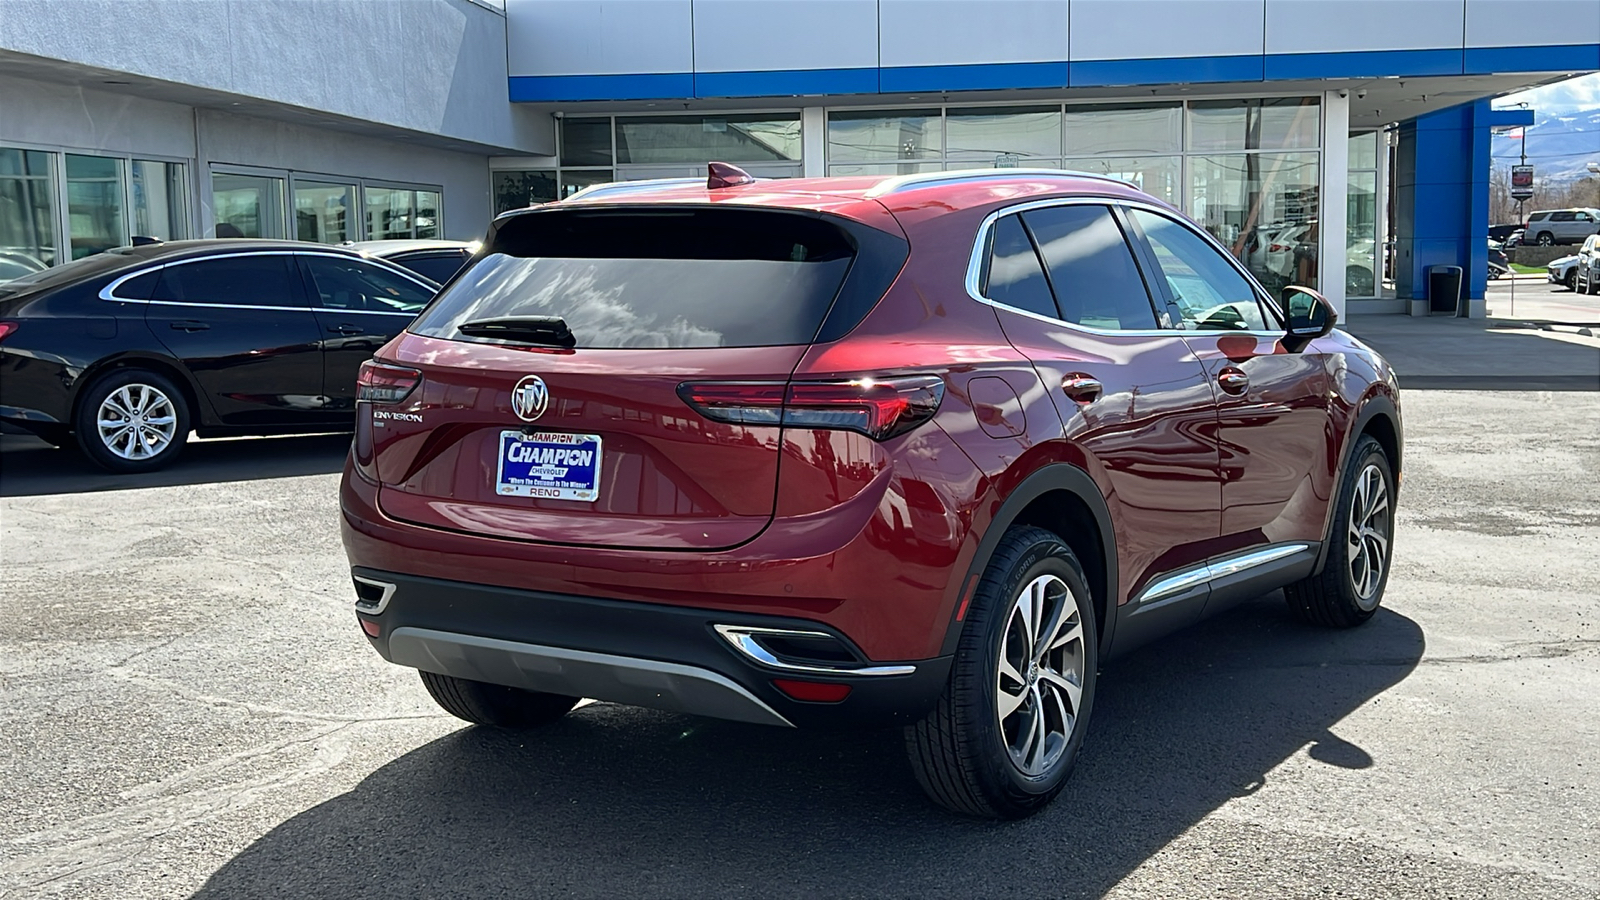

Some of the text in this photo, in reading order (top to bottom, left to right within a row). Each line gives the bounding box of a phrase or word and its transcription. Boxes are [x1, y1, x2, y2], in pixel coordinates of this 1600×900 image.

[374, 411, 423, 423] ENVISION
[526, 433, 573, 443] CHAMPION
[507, 442, 593, 467] CHAMPION
[531, 467, 566, 476] CHEVROLET
[534, 478, 555, 487] Customer
[529, 488, 561, 497] RENO
